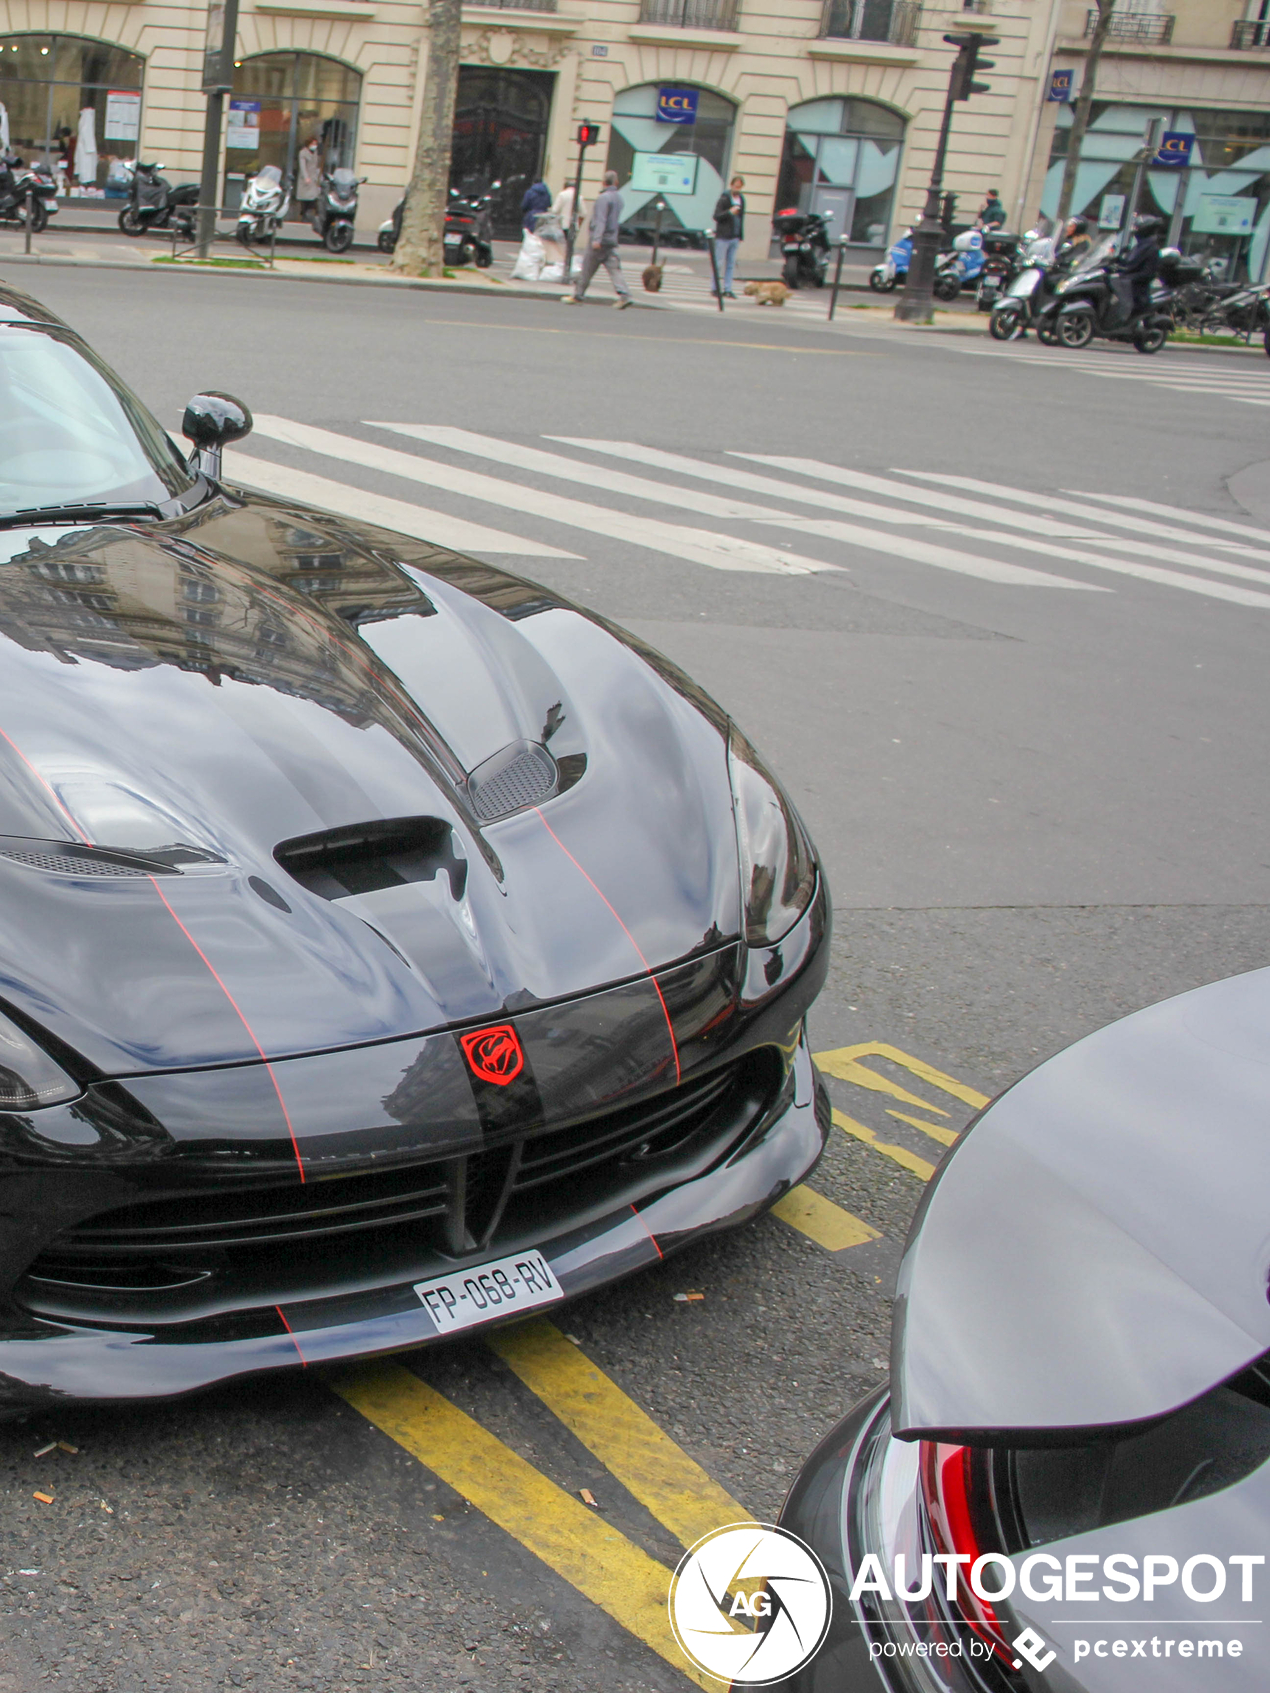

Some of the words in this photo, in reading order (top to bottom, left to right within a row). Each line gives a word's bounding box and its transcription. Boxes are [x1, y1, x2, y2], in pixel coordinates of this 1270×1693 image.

[1053, 76, 1069, 87] LCL
[660, 96, 693, 110] LCL
[1159, 139, 1187, 151] CL
[422, 1257, 552, 1323] FP-068-RV
